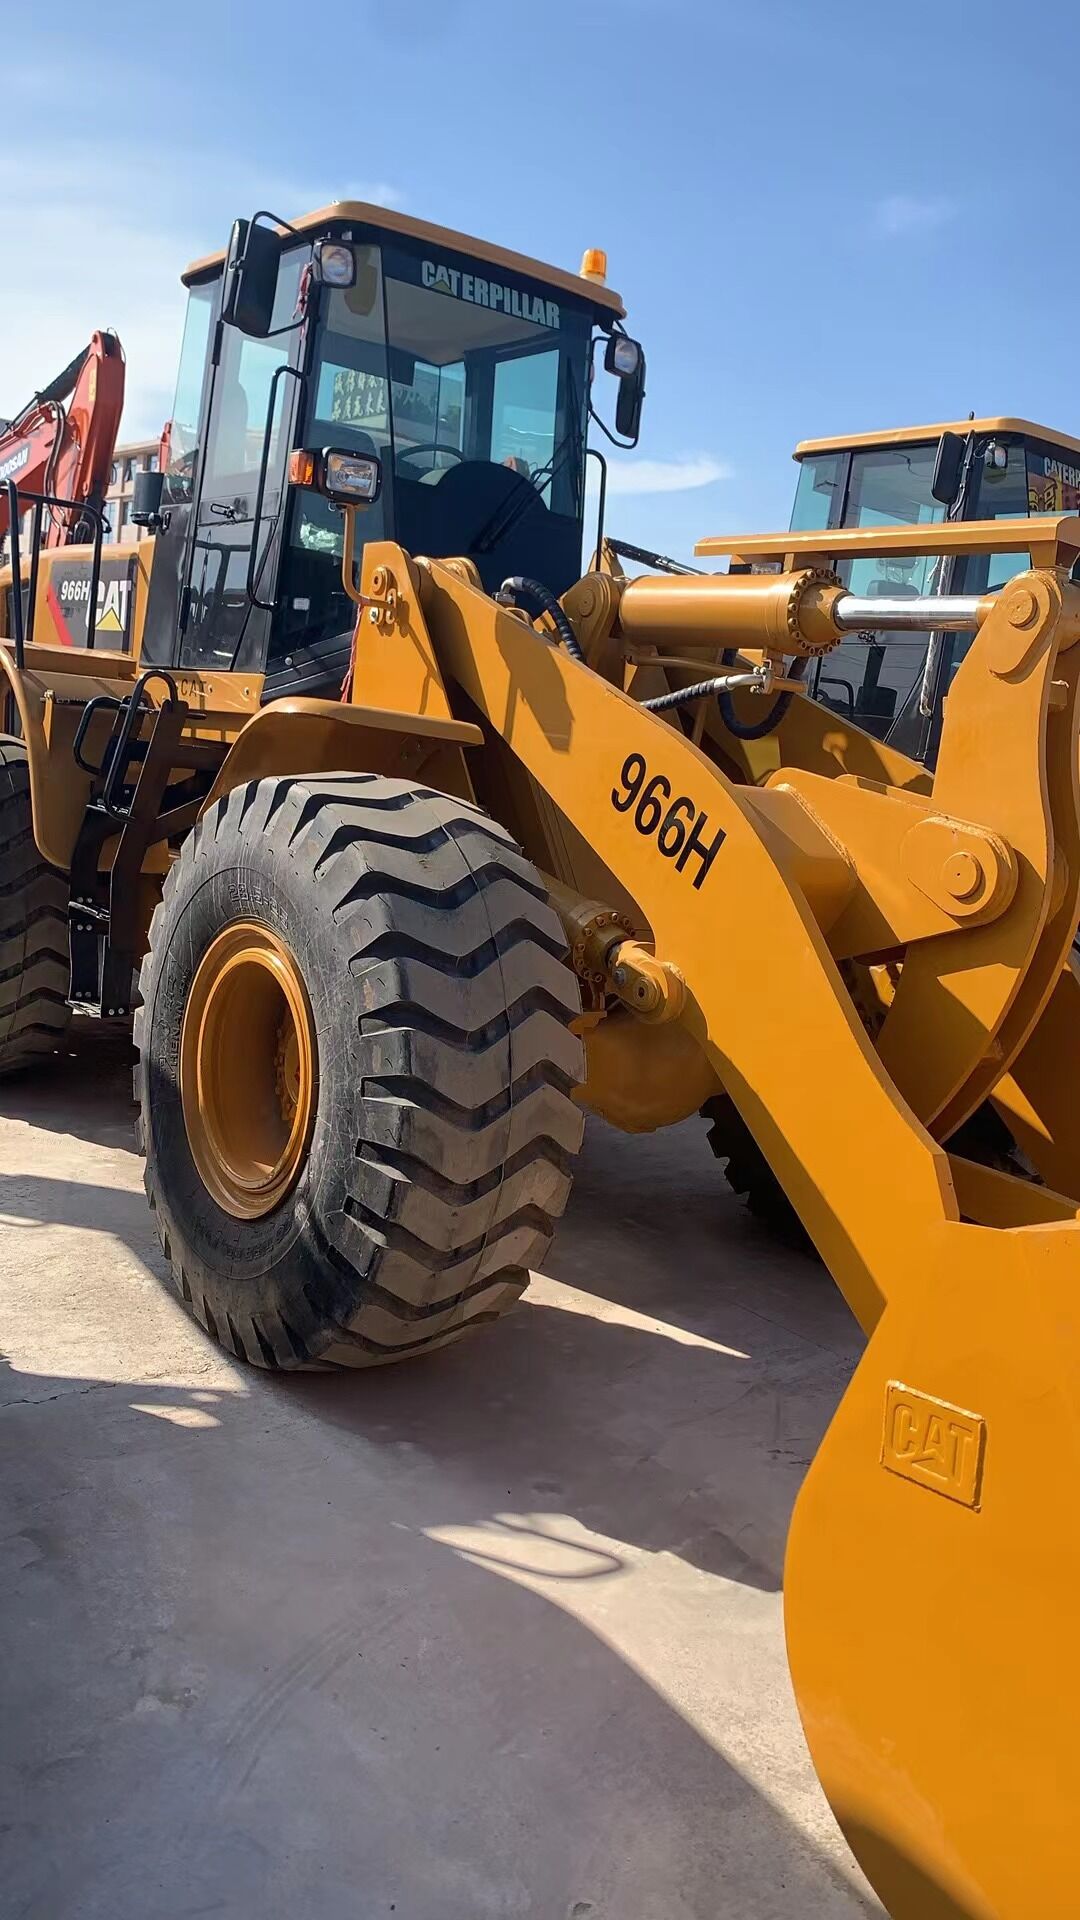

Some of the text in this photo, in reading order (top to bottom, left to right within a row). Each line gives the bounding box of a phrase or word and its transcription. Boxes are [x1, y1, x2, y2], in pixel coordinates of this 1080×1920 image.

[422, 260, 560, 329] CATERPILLAR
[61, 580, 91, 601] 966H
[181, 679, 207, 697] CAT
[611, 752, 727, 890] 966H
[891, 1403, 974, 1487] CAT
